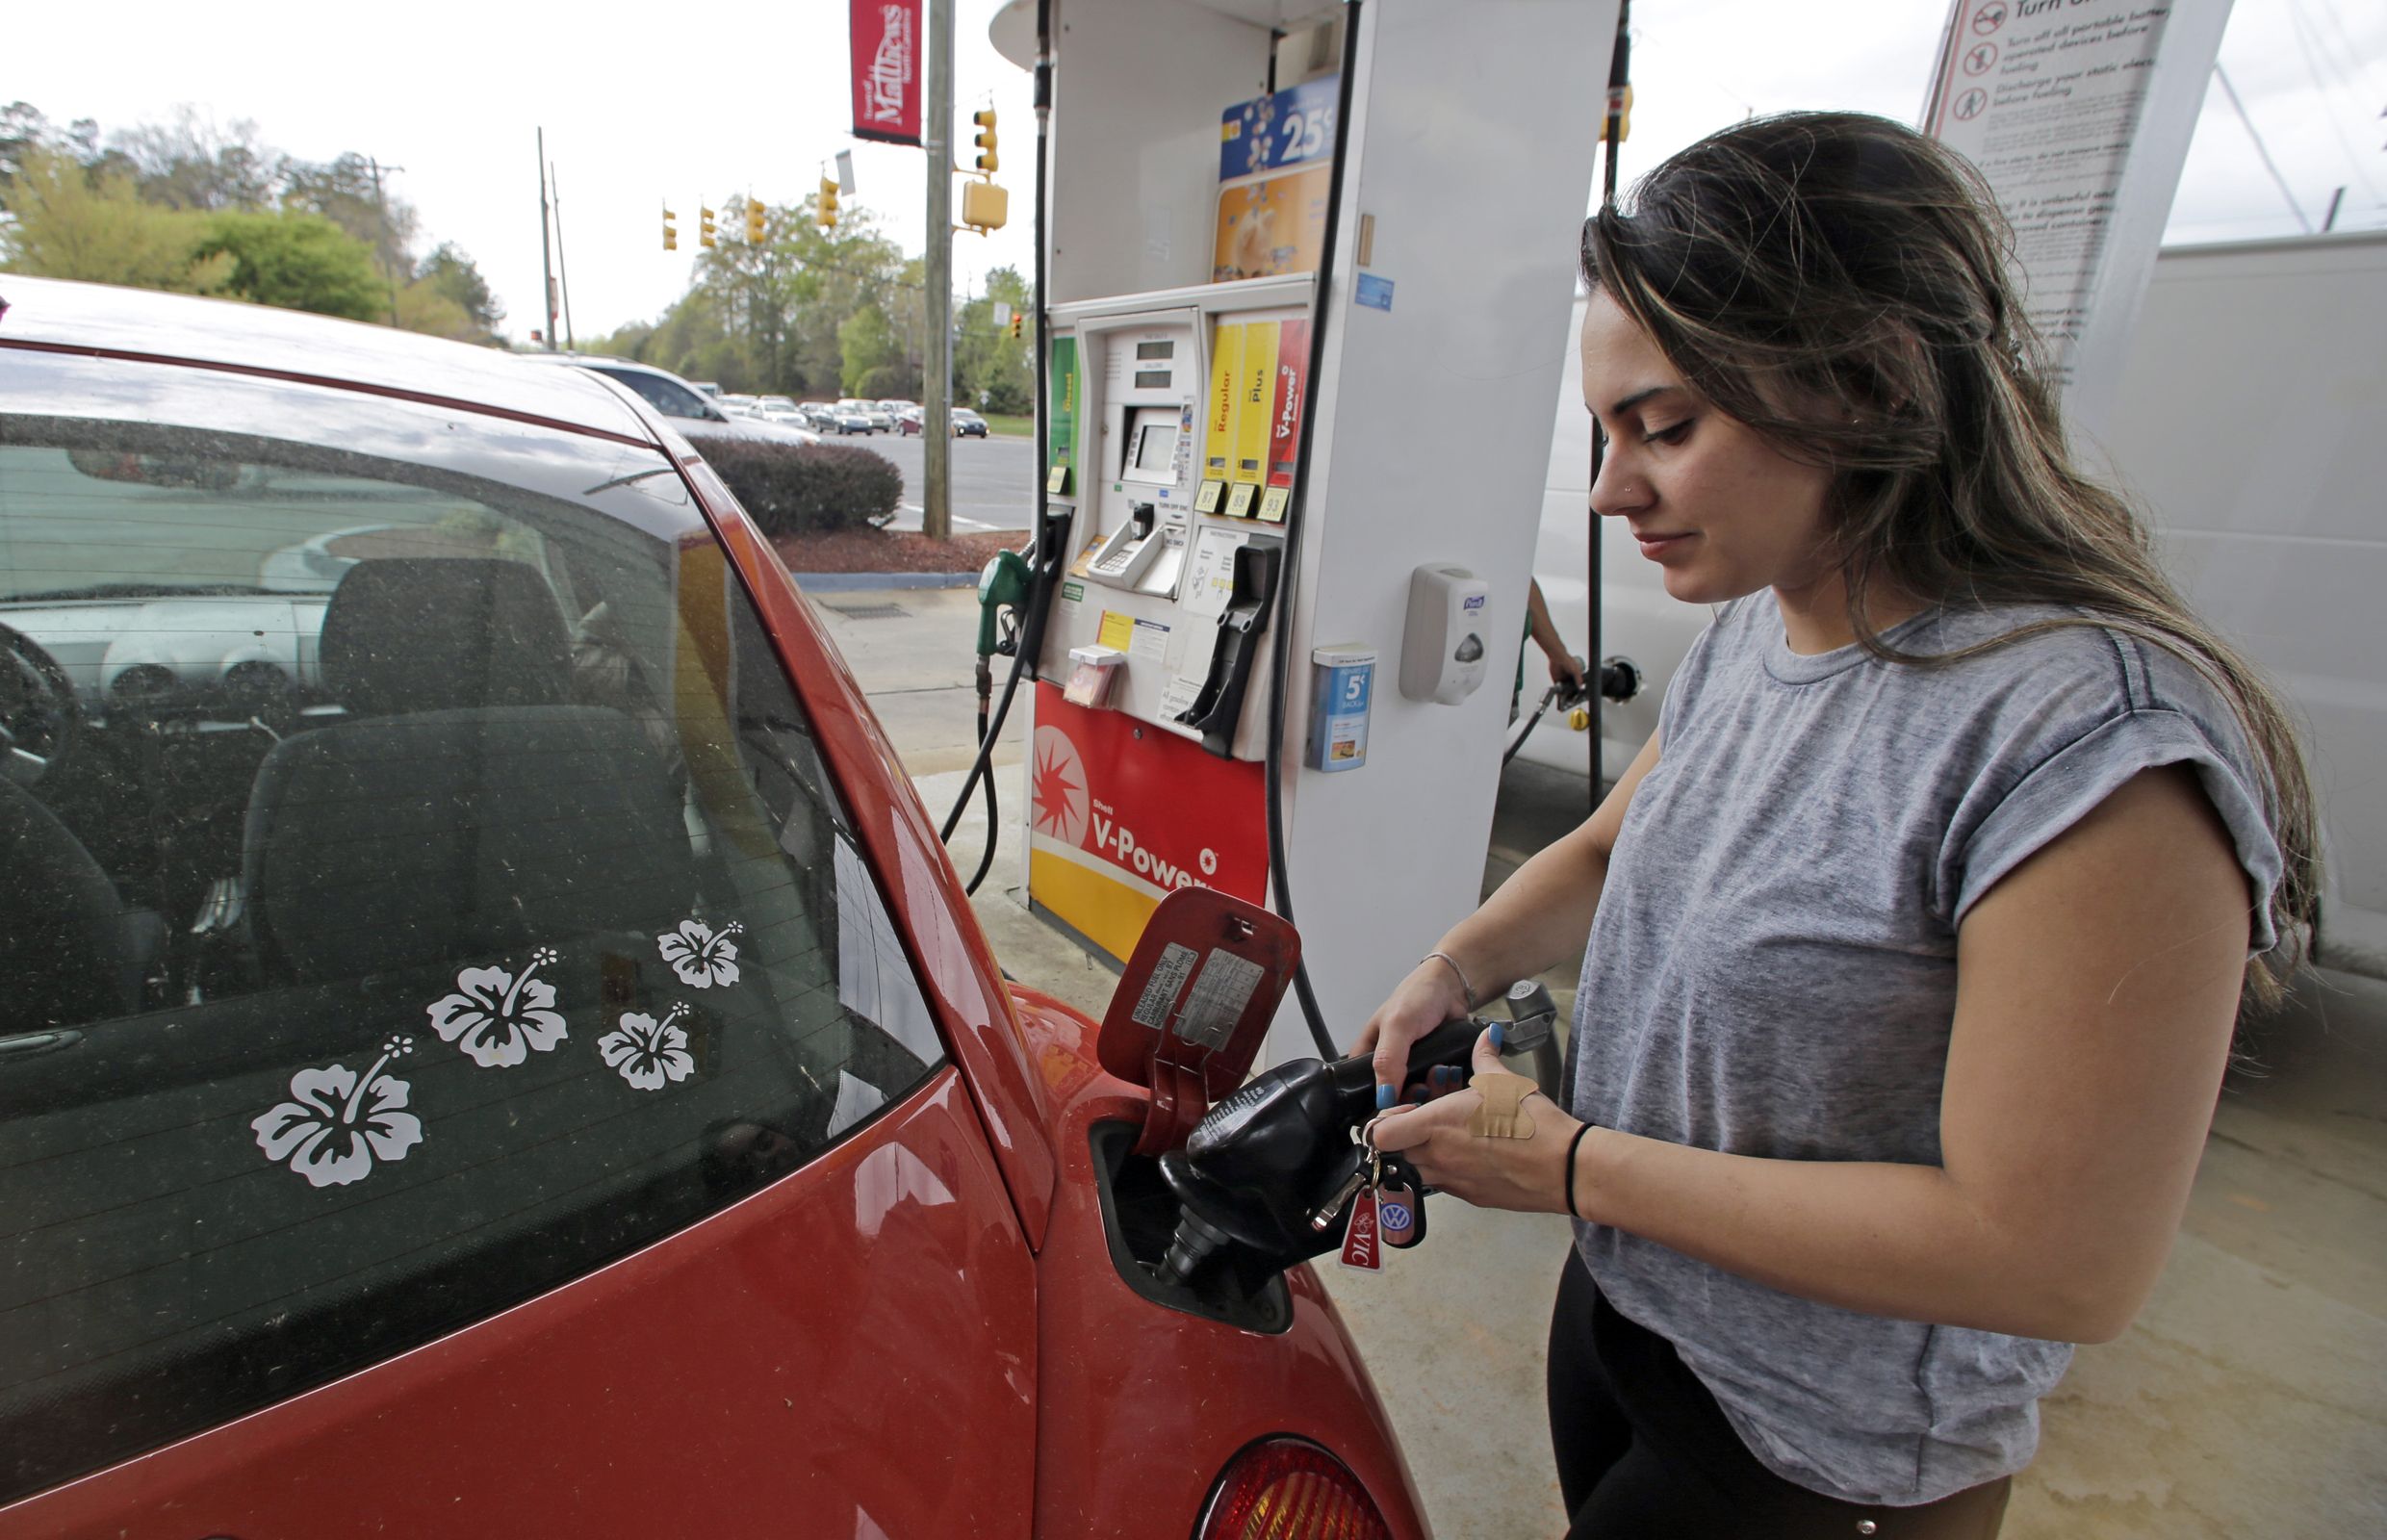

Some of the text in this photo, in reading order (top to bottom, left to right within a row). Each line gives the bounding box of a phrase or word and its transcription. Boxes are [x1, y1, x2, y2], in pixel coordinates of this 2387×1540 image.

[2016, 0, 2060, 17] Turn
[868, 4, 903, 126] Matthews
[1218, 370, 1231, 432] Regular
[1252, 369, 1264, 402] Plus
[1280, 368, 1296, 438] V-Power
[1267, 498, 1279, 511] 93
[1132, 988, 1153, 1020] UNLEADED
[1157, 956, 1168, 972] ONLY
[1140, 994, 1158, 1022] REGULAR
[1352, 1233, 1372, 1266] VIC
